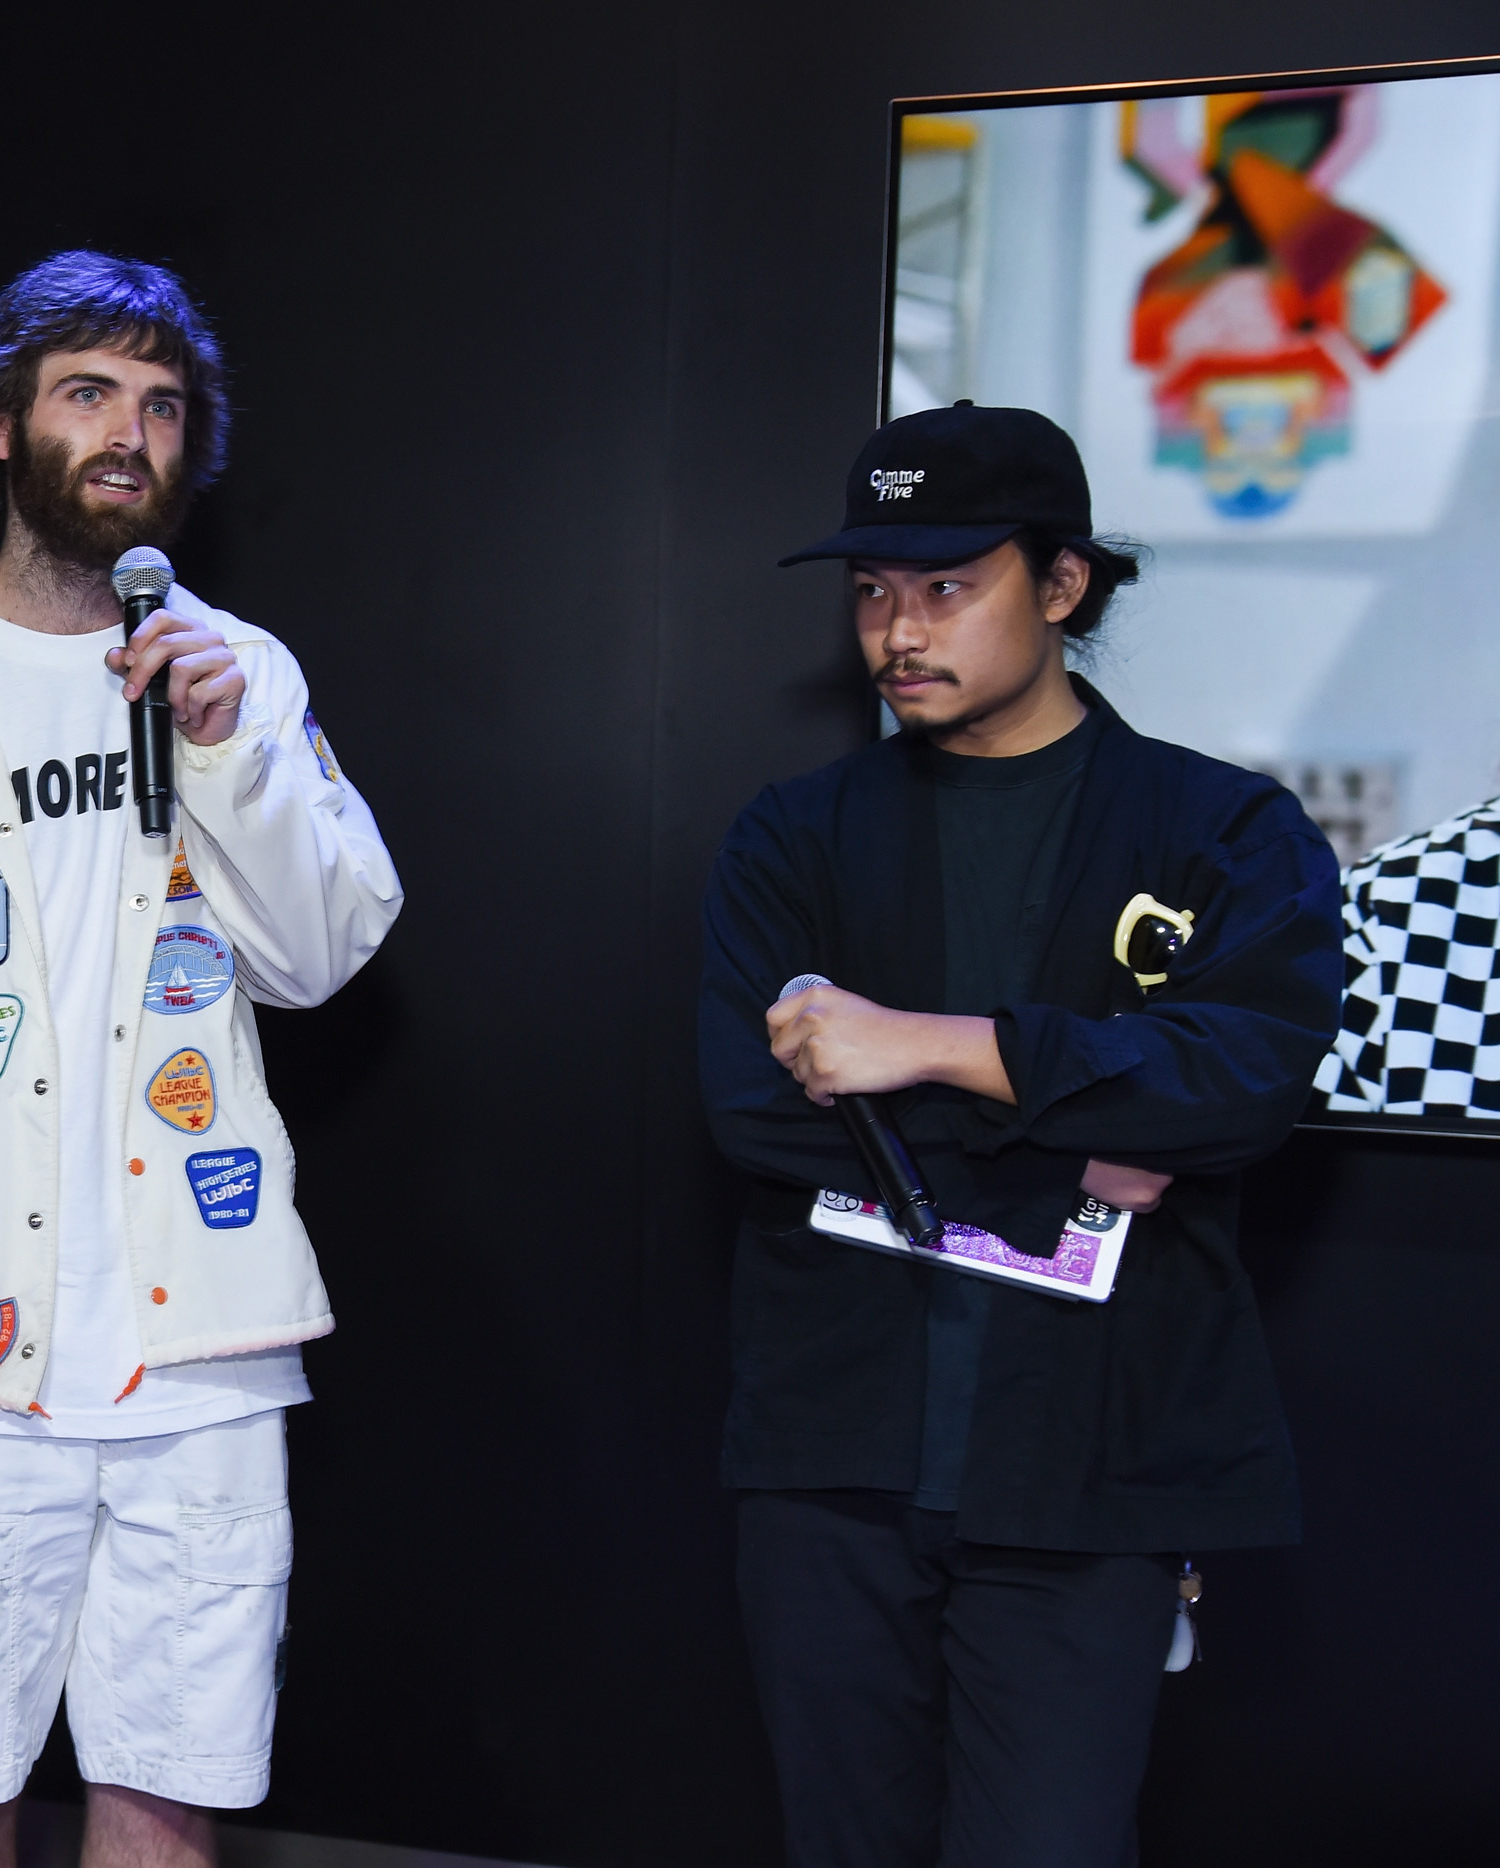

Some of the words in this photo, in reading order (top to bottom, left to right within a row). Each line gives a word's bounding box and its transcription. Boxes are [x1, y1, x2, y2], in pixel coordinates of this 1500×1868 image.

[870, 468, 925, 490] Gimme
[877, 484, 913, 501] Five
[178, 931, 218, 950] CHRISTI
[160, 1077, 203, 1093] LEAGUE
[153, 1089, 211, 1107] CHAMPION
[191, 1156, 236, 1168] LEAGUE
[208, 1208, 249, 1219] 1980-81
